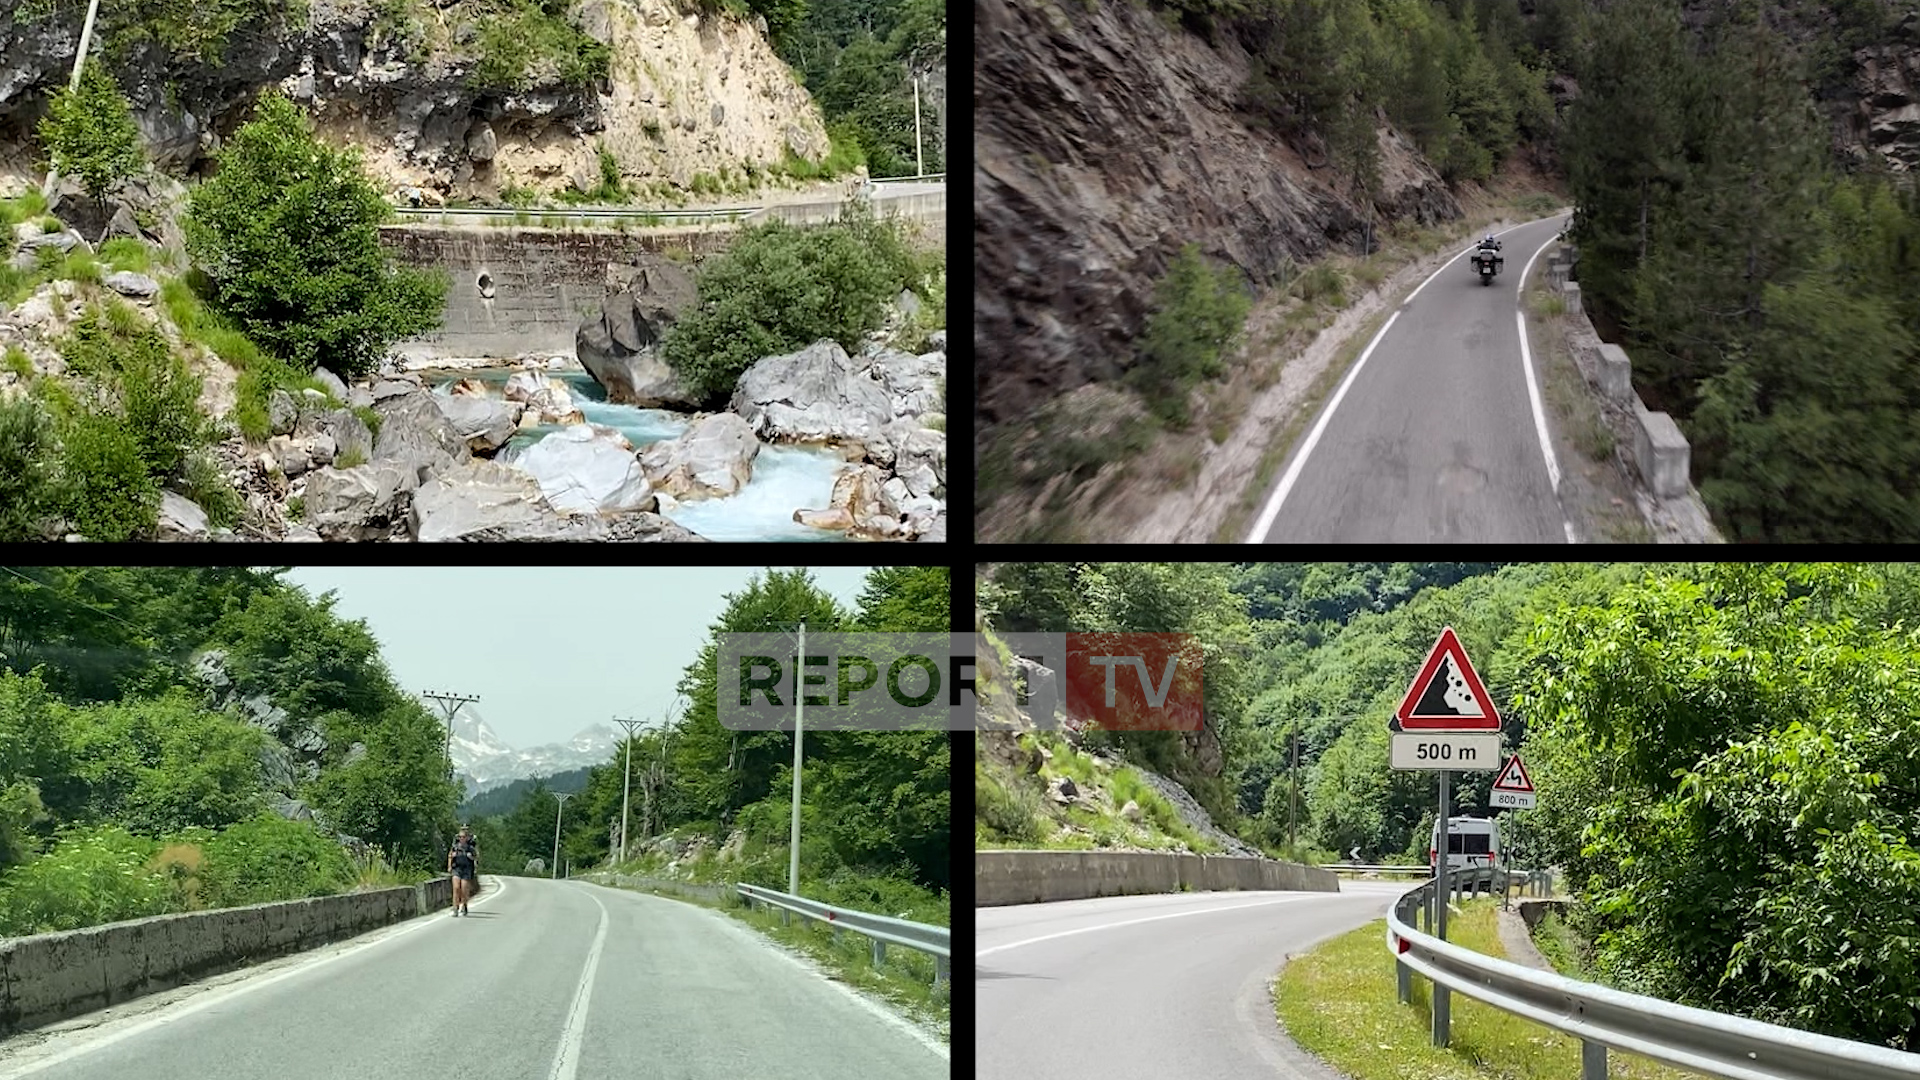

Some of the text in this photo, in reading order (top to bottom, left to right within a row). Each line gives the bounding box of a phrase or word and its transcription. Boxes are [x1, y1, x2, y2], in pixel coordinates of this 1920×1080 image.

[1417, 743, 1476, 760] 500 m
[1498, 794, 1528, 806] 800 m
